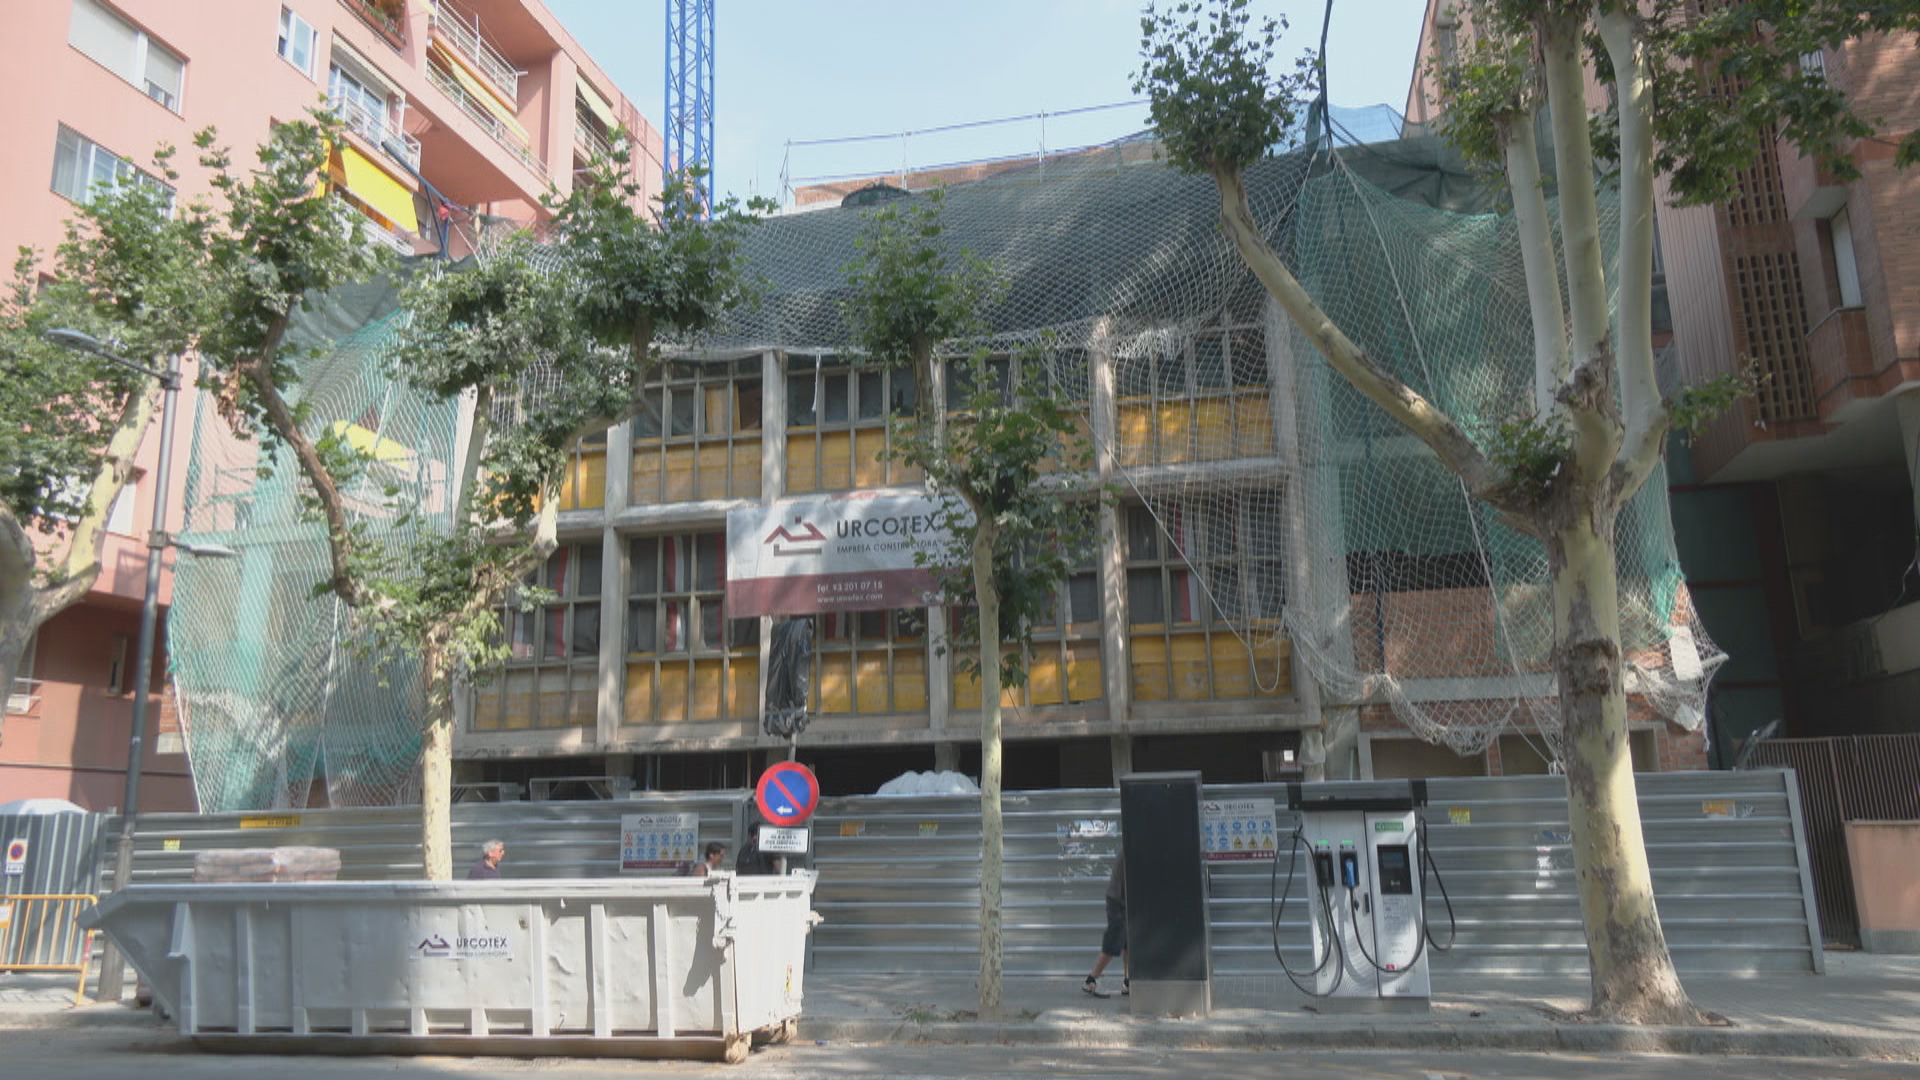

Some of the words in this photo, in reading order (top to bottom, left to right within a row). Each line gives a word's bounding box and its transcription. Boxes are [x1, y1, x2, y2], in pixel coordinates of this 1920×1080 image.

[836, 515, 937, 538] URCOTEX
[836, 544, 871, 554] EMPRESA
[860, 581, 871, 591] 07
[456, 938, 508, 949] URCOTEX
